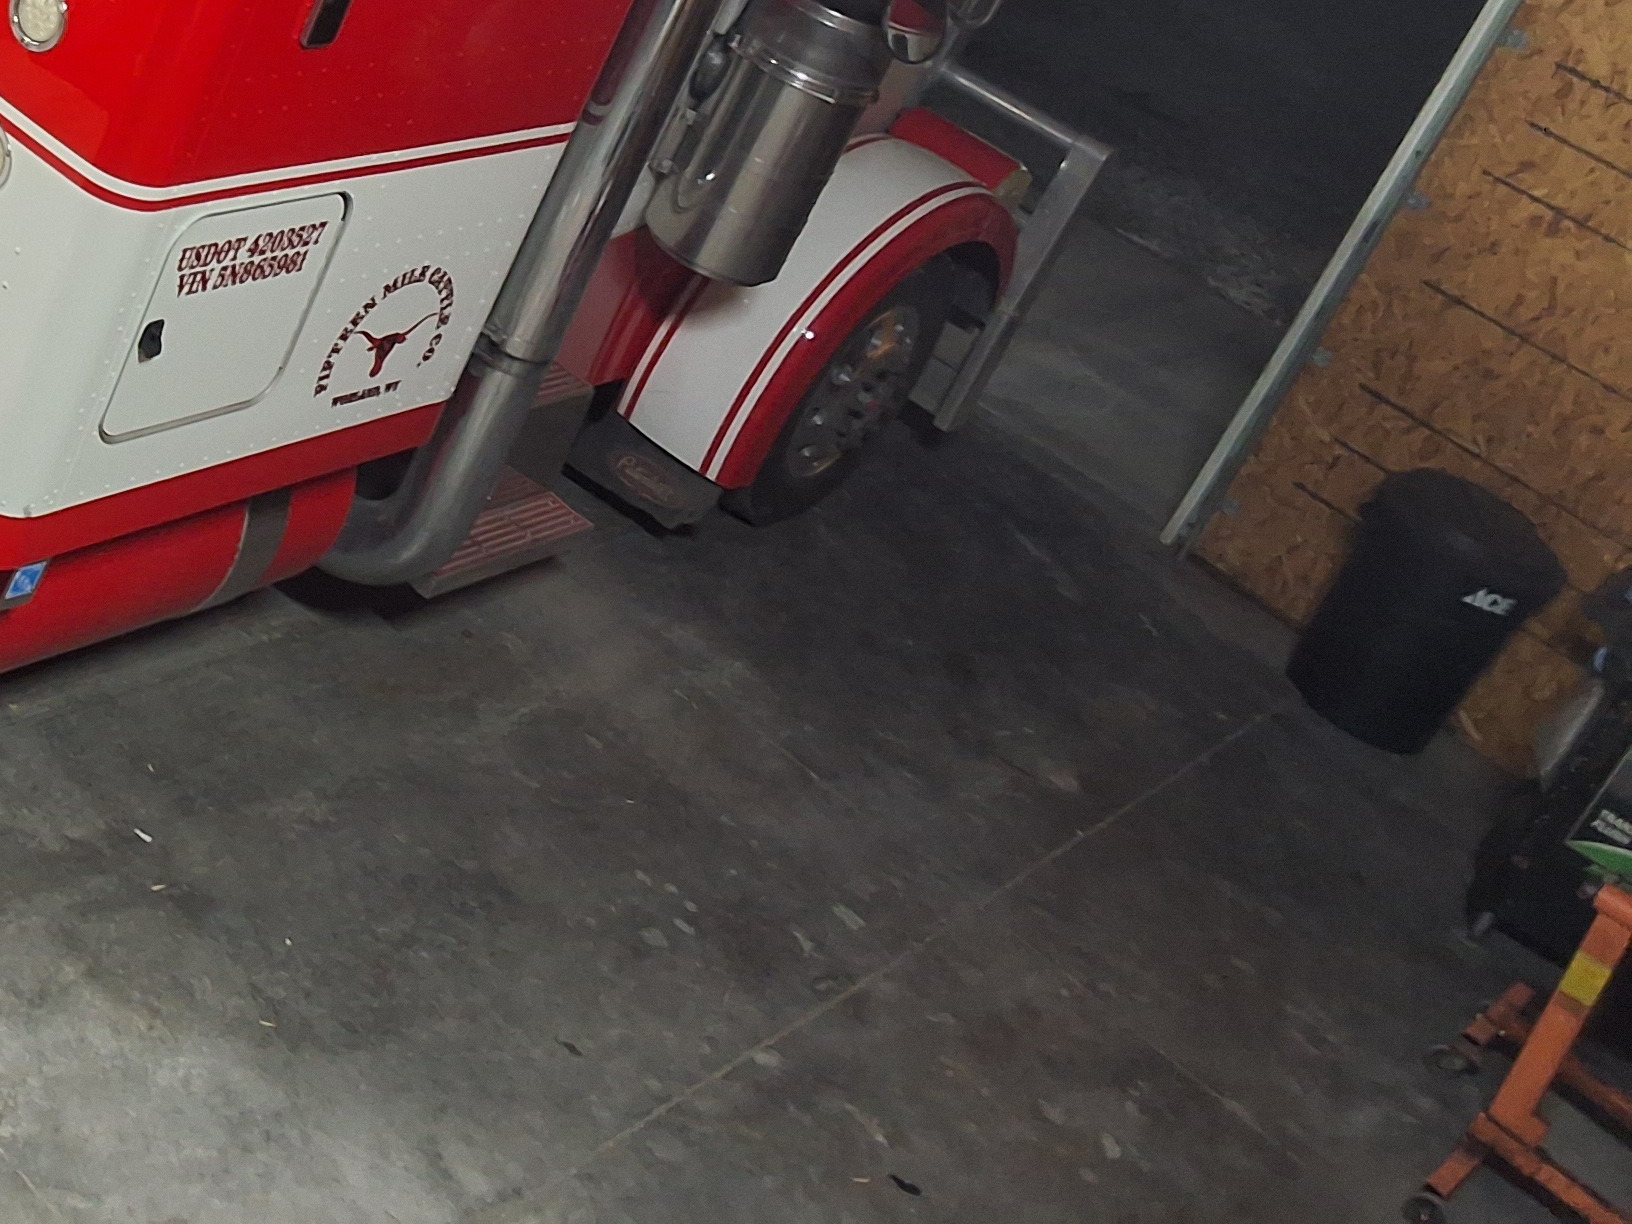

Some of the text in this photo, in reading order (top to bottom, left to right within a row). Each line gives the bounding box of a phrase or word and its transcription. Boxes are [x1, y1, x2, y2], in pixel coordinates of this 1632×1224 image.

[177, 221, 329, 272] USDOT 4203527
[176, 268, 215, 298] VIN
[381, 265, 431, 300] MILE
[428, 267, 454, 330] CATTLE
[1462, 588, 1518, 615] ACE
